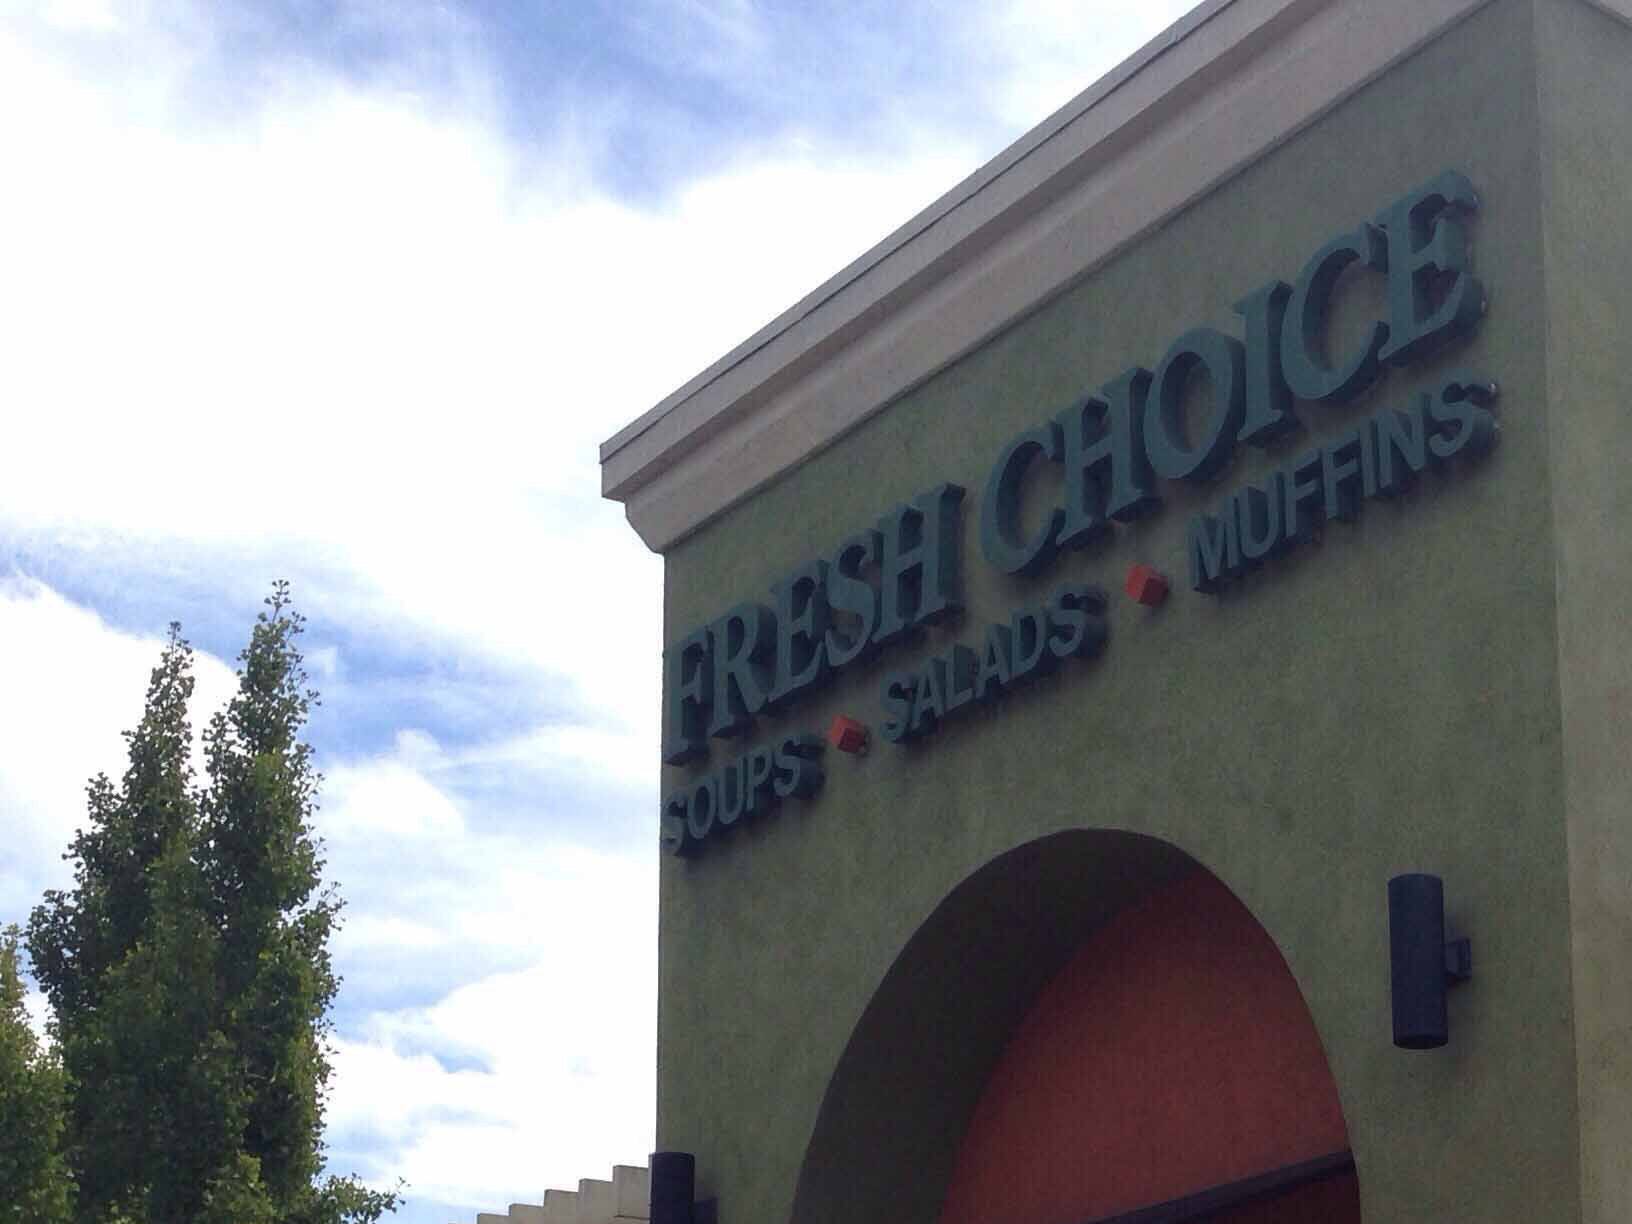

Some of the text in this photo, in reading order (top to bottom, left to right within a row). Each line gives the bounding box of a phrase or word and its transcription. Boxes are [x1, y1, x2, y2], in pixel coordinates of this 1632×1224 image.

[661, 367, 1498, 858] SOUPS SALADS MUFFINS
[663, 169, 1486, 766] FRESH CHOICE
